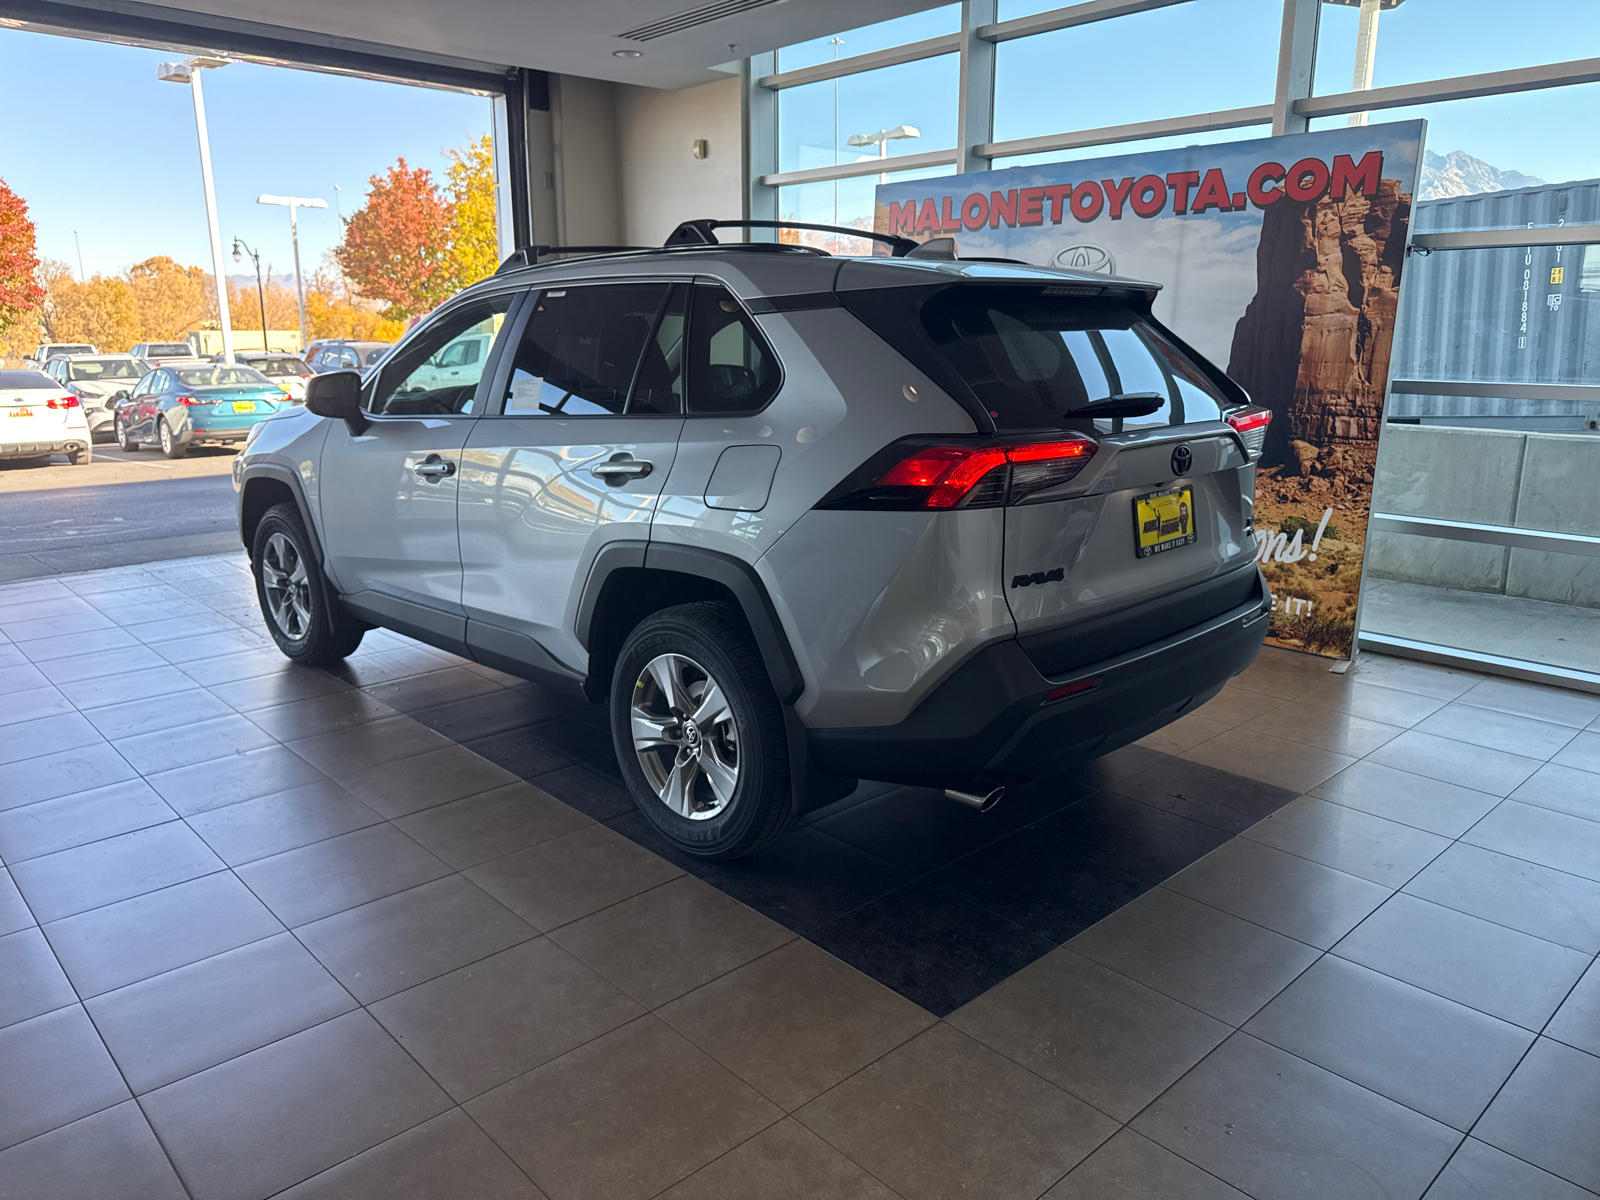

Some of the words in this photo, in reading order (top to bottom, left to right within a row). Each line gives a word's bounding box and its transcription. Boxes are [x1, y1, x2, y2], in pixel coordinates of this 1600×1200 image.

[888, 150, 1384, 236] MALONETOYOTA.COM
[1011, 567, 1065, 589] RAV4
[1285, 596, 1313, 618] IT!
